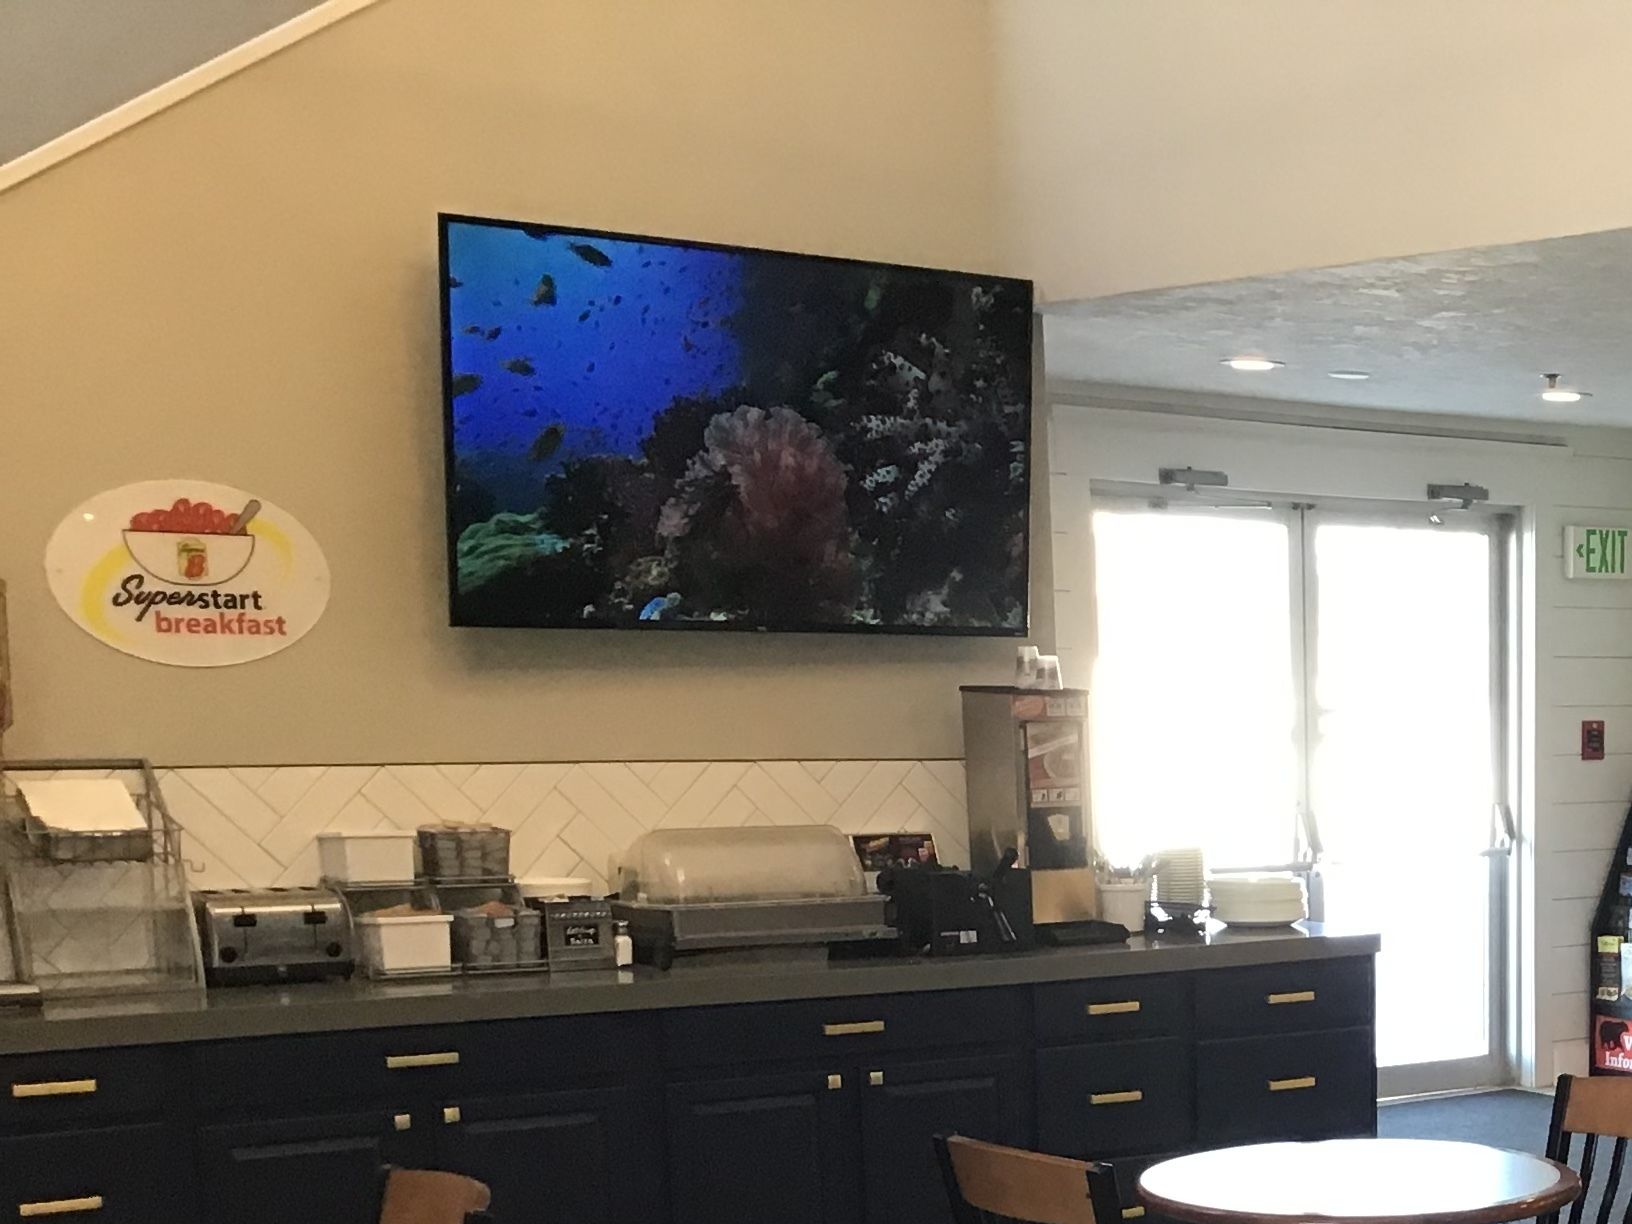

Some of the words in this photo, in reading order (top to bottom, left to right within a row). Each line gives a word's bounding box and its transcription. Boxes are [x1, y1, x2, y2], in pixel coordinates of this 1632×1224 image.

[1585, 528, 1628, 574] EXIT
[112, 573, 263, 622] Superstart
[155, 610, 287, 636] breakfast
